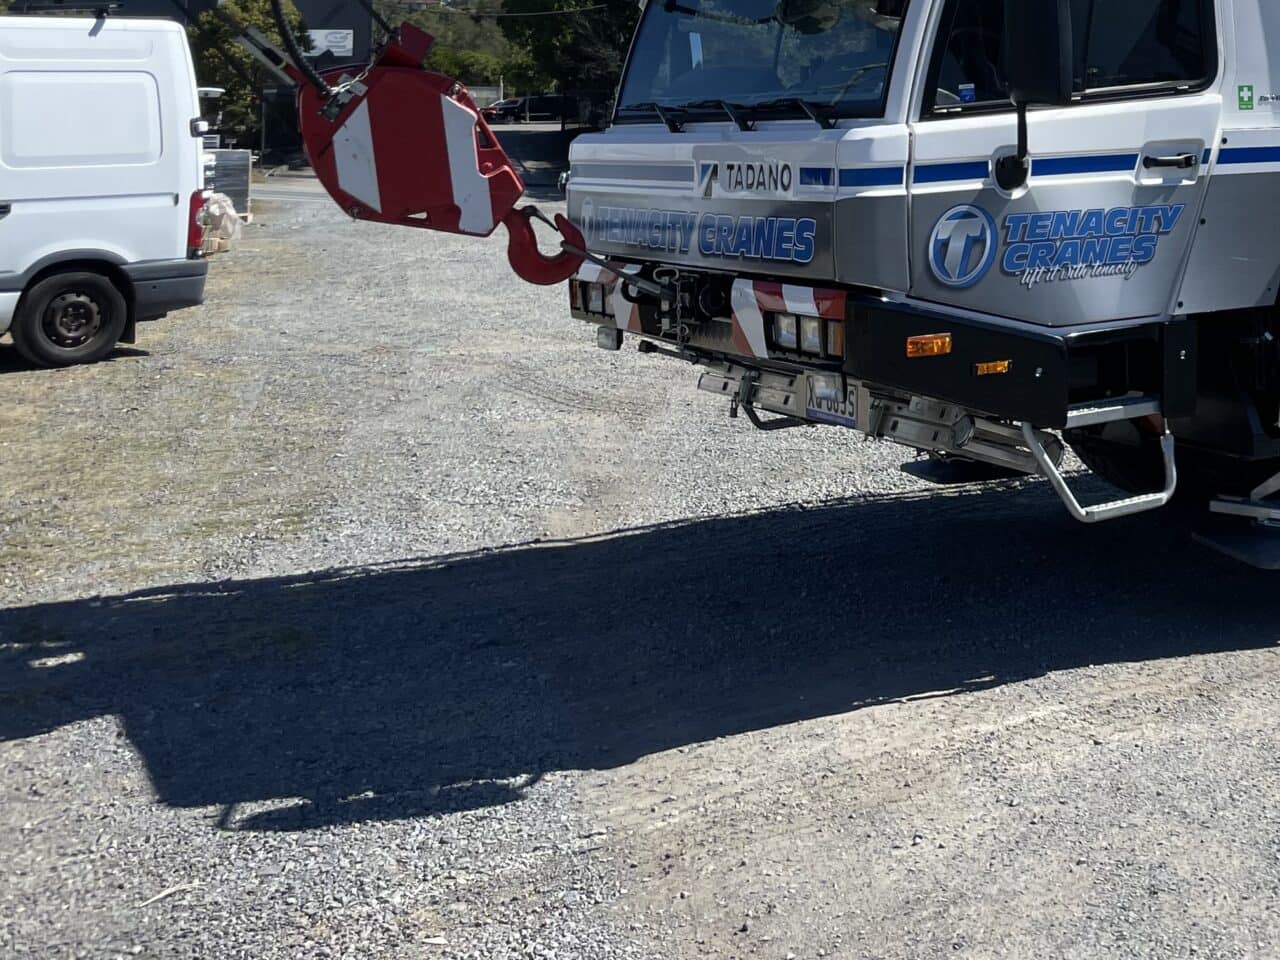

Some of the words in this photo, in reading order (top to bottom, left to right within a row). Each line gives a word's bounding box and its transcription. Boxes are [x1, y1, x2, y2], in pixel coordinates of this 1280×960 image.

[726, 163, 792, 192] TADANO
[597, 206, 699, 253] TENACITY
[698, 213, 816, 263] CRANES
[1005, 204, 1186, 242] TENACITY
[1002, 234, 1159, 273] CRANES
[1091, 258, 1138, 280] tenacity
